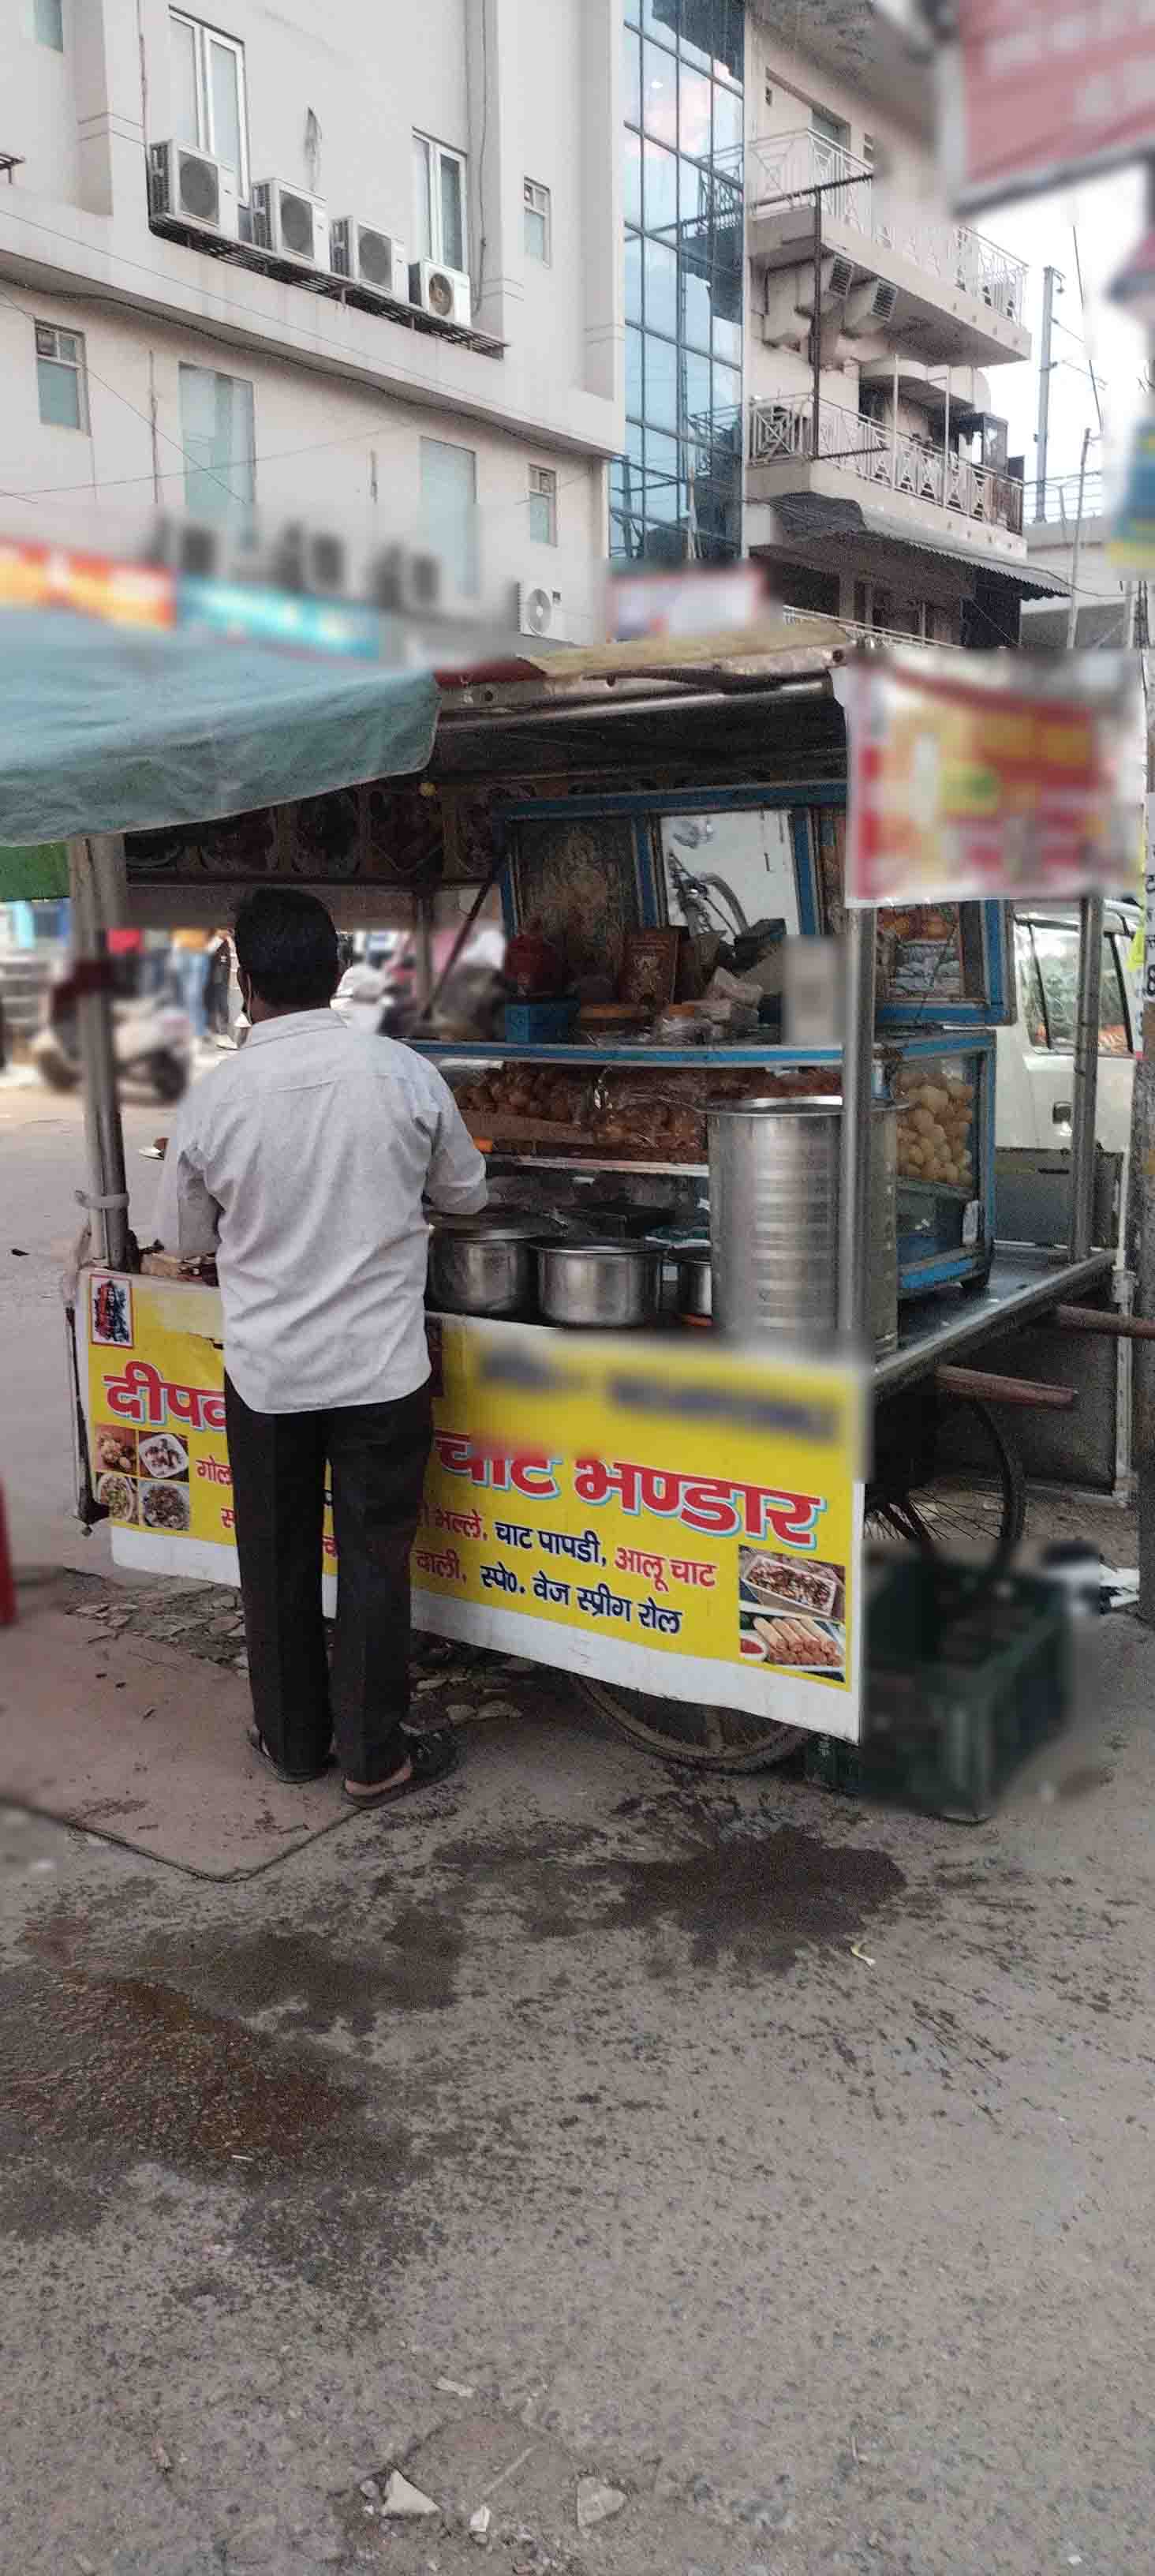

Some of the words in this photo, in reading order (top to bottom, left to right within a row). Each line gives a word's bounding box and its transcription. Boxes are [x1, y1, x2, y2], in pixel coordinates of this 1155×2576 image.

[574, 1452, 826, 1549] भण्डार
[494, 1522, 533, 1549] चाट
[614, 1546, 669, 1593] आलू
[669, 1559, 718, 1587] चाट
[532, 1569, 571, 1605] वेज
[637, 1596, 683, 1635] रोल
